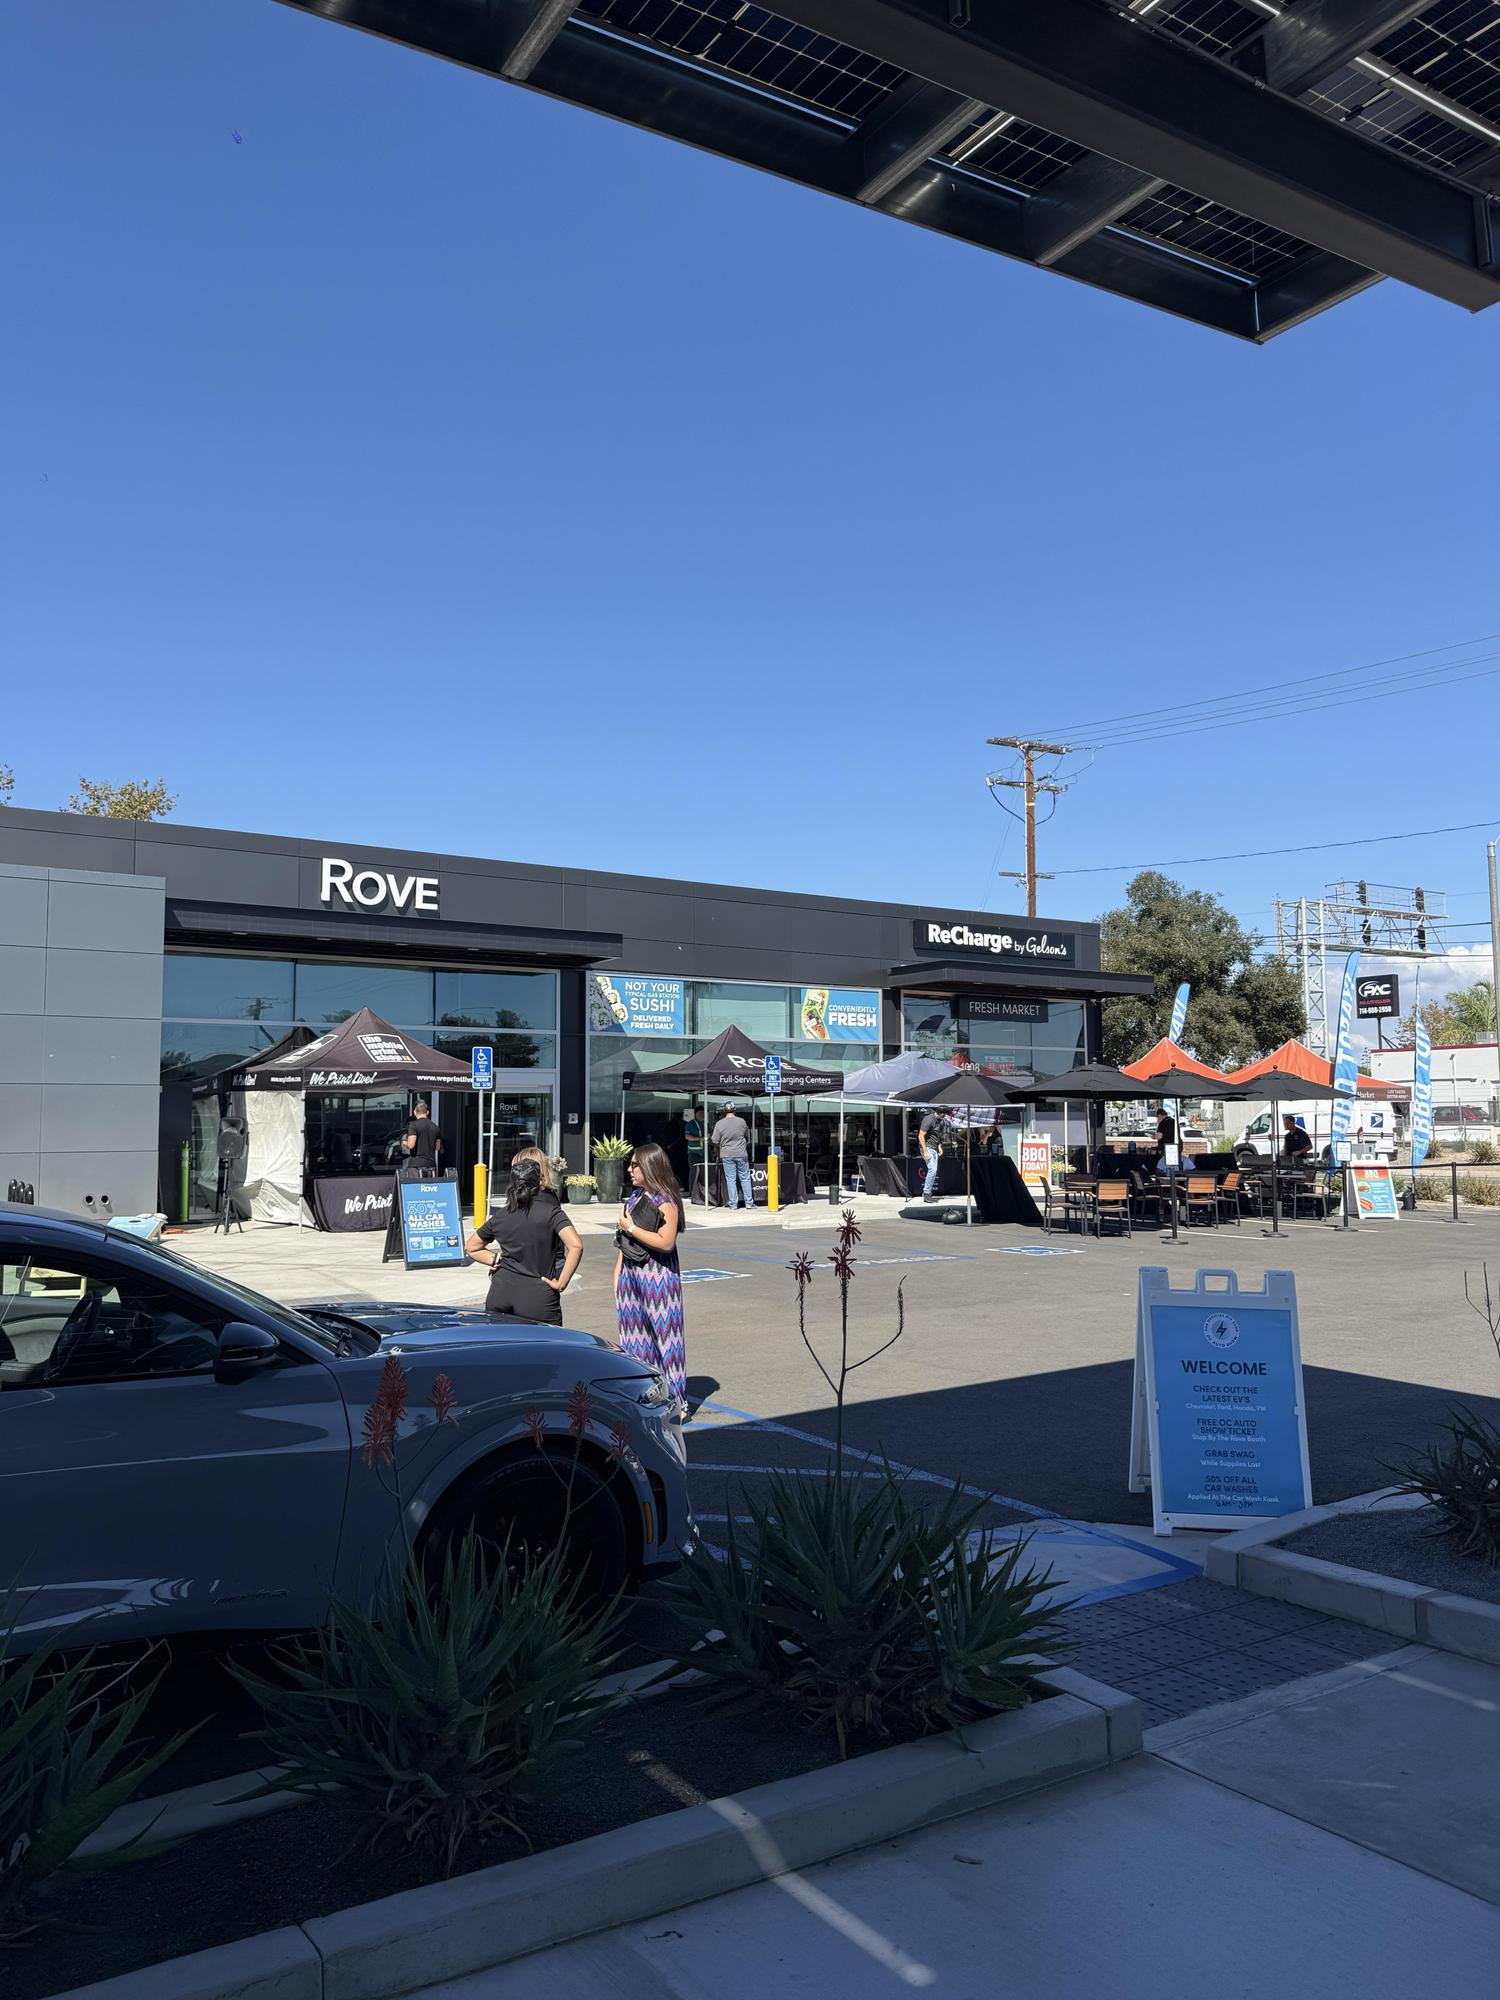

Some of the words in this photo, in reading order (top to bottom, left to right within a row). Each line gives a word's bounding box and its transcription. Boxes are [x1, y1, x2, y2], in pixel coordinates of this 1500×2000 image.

[321, 857, 438, 910] ROVE
[928, 924, 1012, 953] ReCharge
[1015, 942, 1025, 955] by
[1026, 935, 1067, 956] Gelson's
[625, 982, 647, 991] NOT
[651, 983, 680, 992] YOUR
[630, 998, 674, 1012] SUSHI
[828, 1004, 877, 1013] CONVENIENTLY
[970, 1002, 1000, 1014] FRESH
[1002, 1004, 1040, 1016] MARKET
[828, 1012, 877, 1027] FRESH
[728, 1055, 797, 1070] ROE
[310, 1072, 326, 1085] We
[326, 1072, 353, 1085] Print
[352, 1072, 378, 1084] Live!
[720, 1075, 760, 1084] Full-Service
[1022, 1147, 1047, 1162] BBQ
[344, 1196, 363, 1214] We
[364, 1194, 392, 1210] Print
[1182, 1360, 1267, 1376] WELCOME
[1202, 1394, 1231, 1402] LATEST
[1234, 1420, 1256, 1428] AUTO
[1228, 1428, 1257, 1436] TICKET
[1204, 1450, 1228, 1458] GRAB
[1230, 1450, 1256, 1458] SWAG
